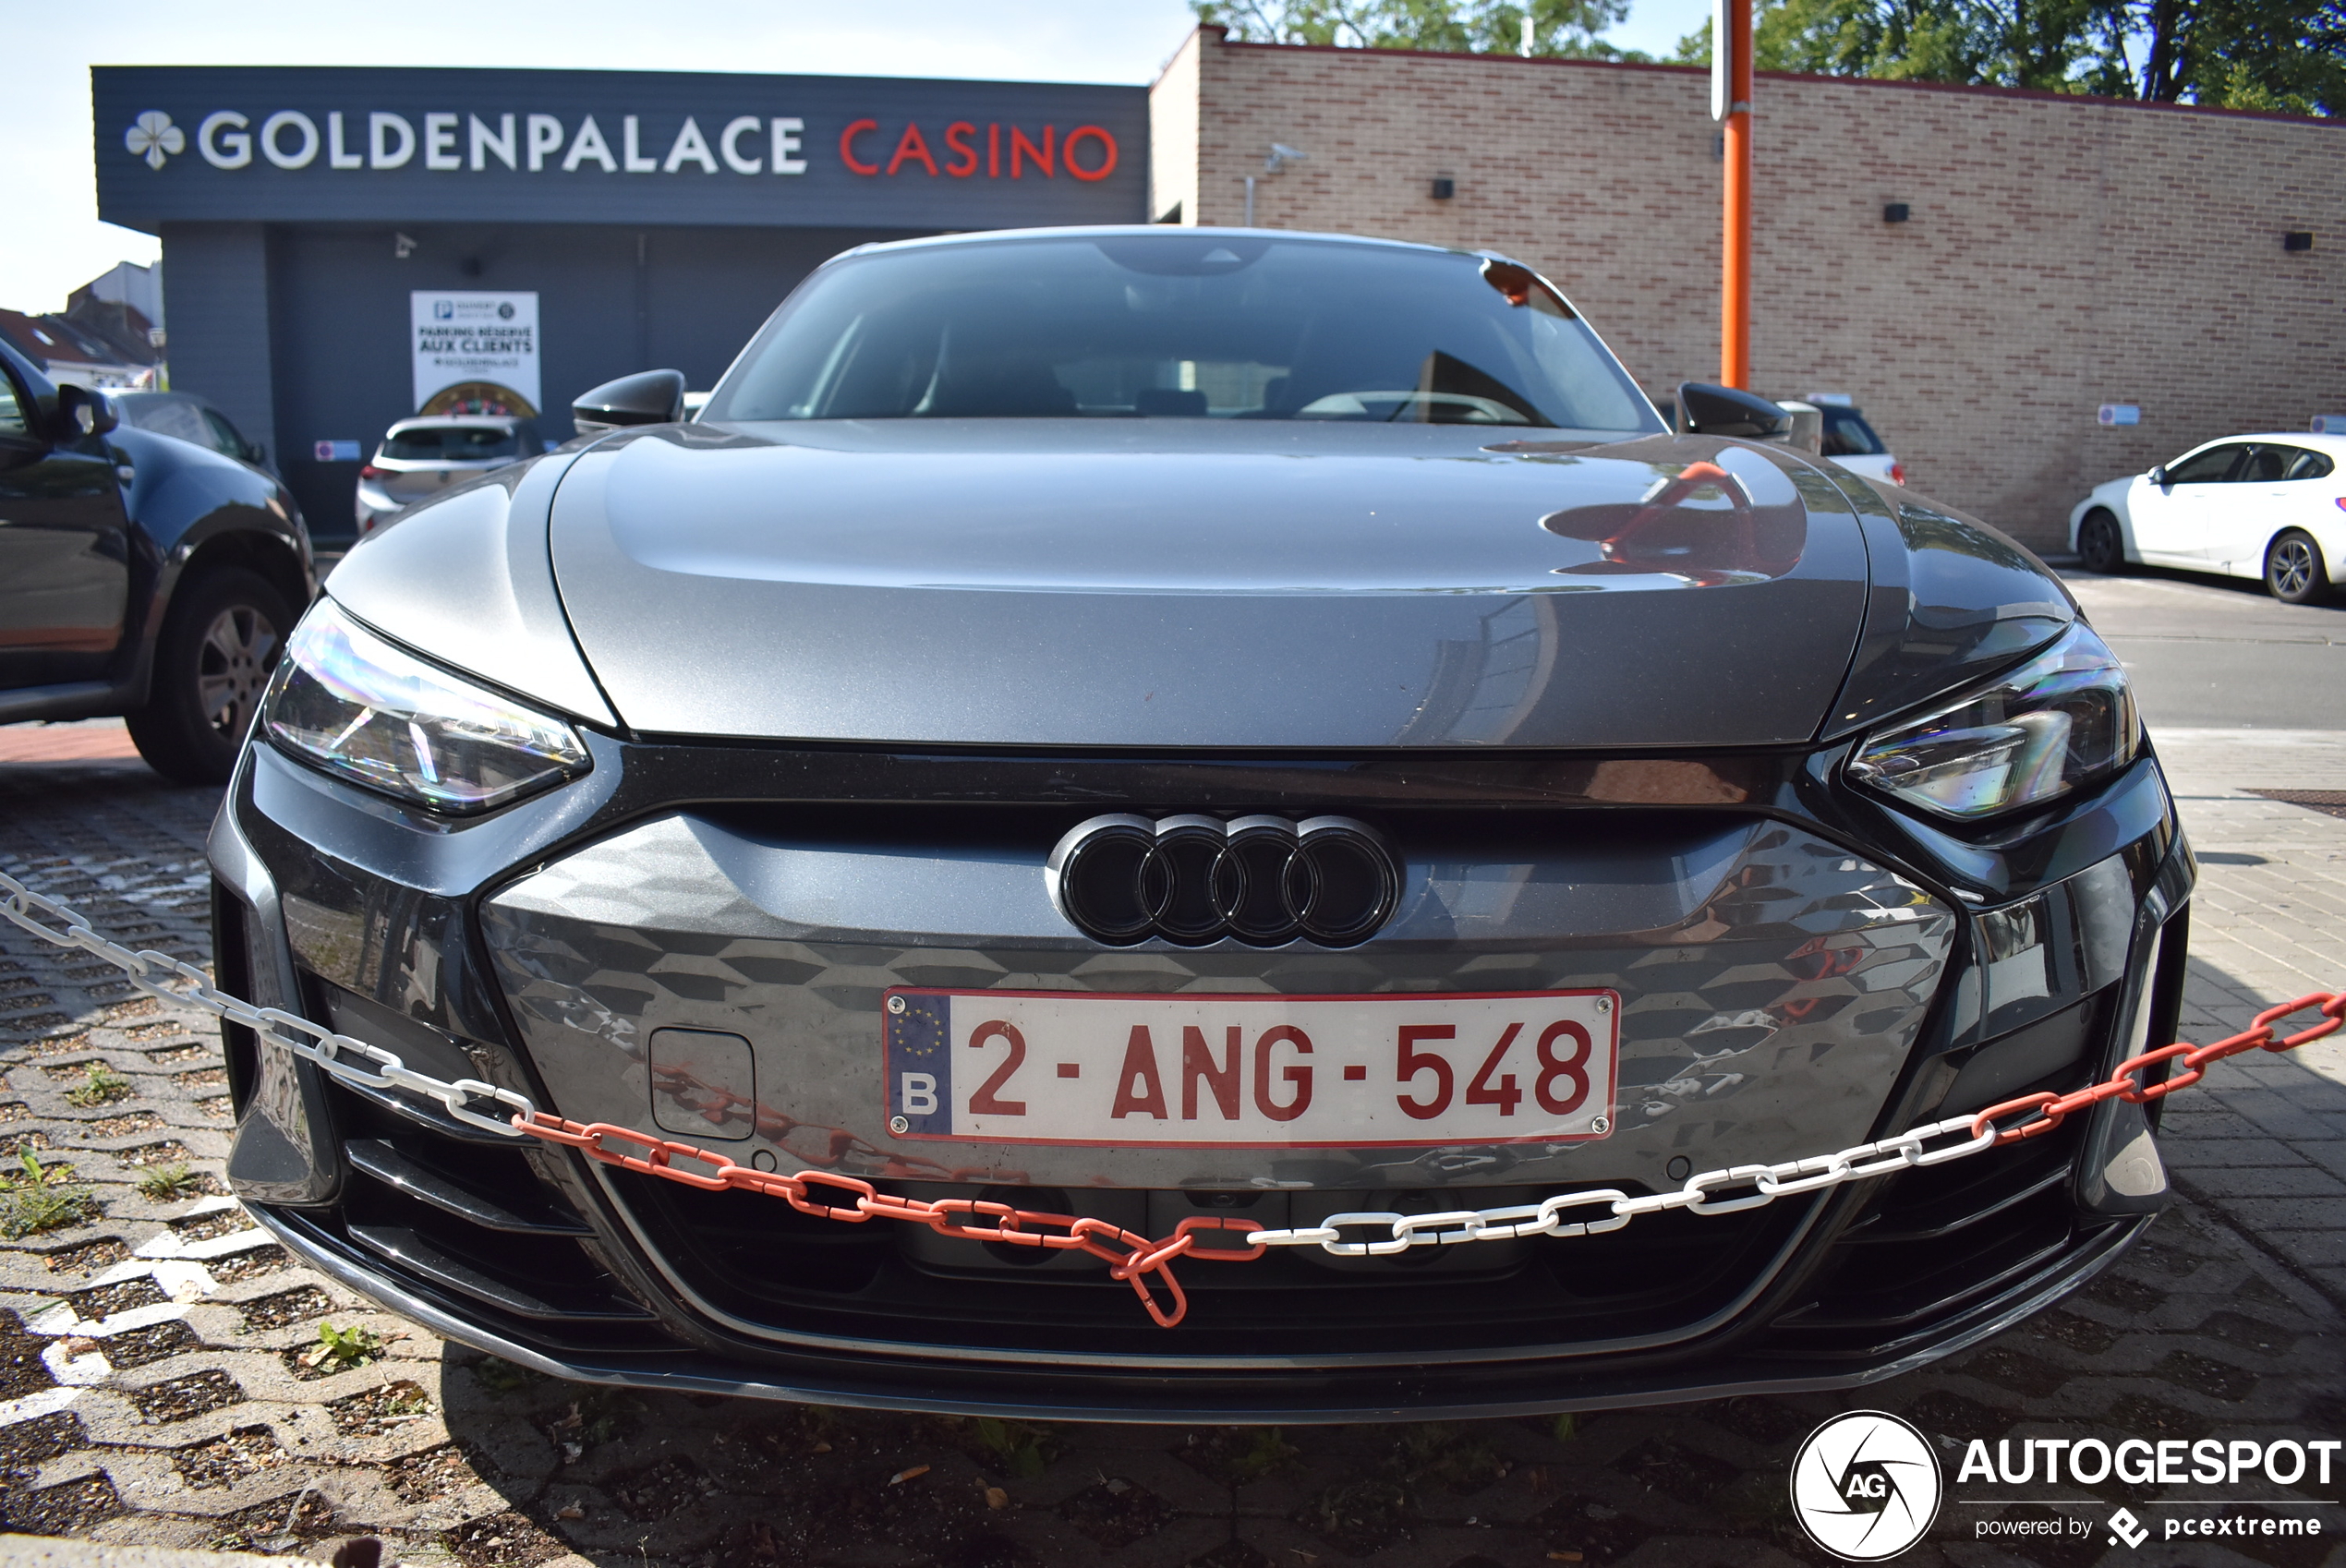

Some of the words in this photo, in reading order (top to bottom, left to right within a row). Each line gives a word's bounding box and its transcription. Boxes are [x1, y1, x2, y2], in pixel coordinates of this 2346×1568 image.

[198, 109, 808, 175] GOLDENPALACE
[839, 118, 1119, 183] CASINO
[419, 327, 475, 336] PARKING
[419, 341, 456, 353] AUX
[461, 340, 533, 353] CLIENTS
[901, 1072, 938, 1116] B
